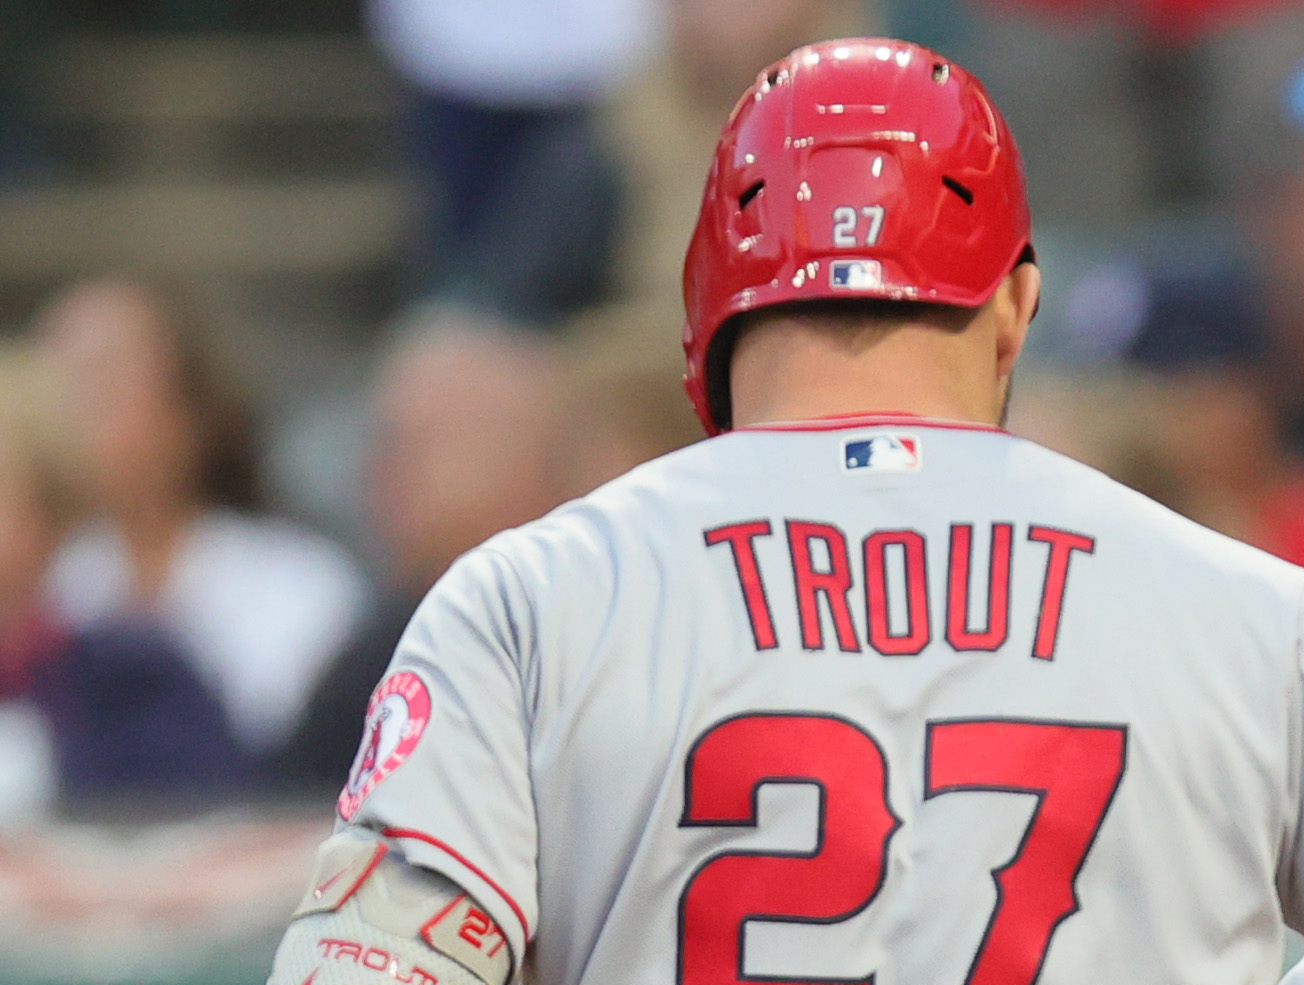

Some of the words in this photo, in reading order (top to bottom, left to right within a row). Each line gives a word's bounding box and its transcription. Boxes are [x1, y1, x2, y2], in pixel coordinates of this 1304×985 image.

[832, 205, 886, 249] 27
[702, 516, 1097, 662] TROUT
[458, 906, 509, 960] 27
